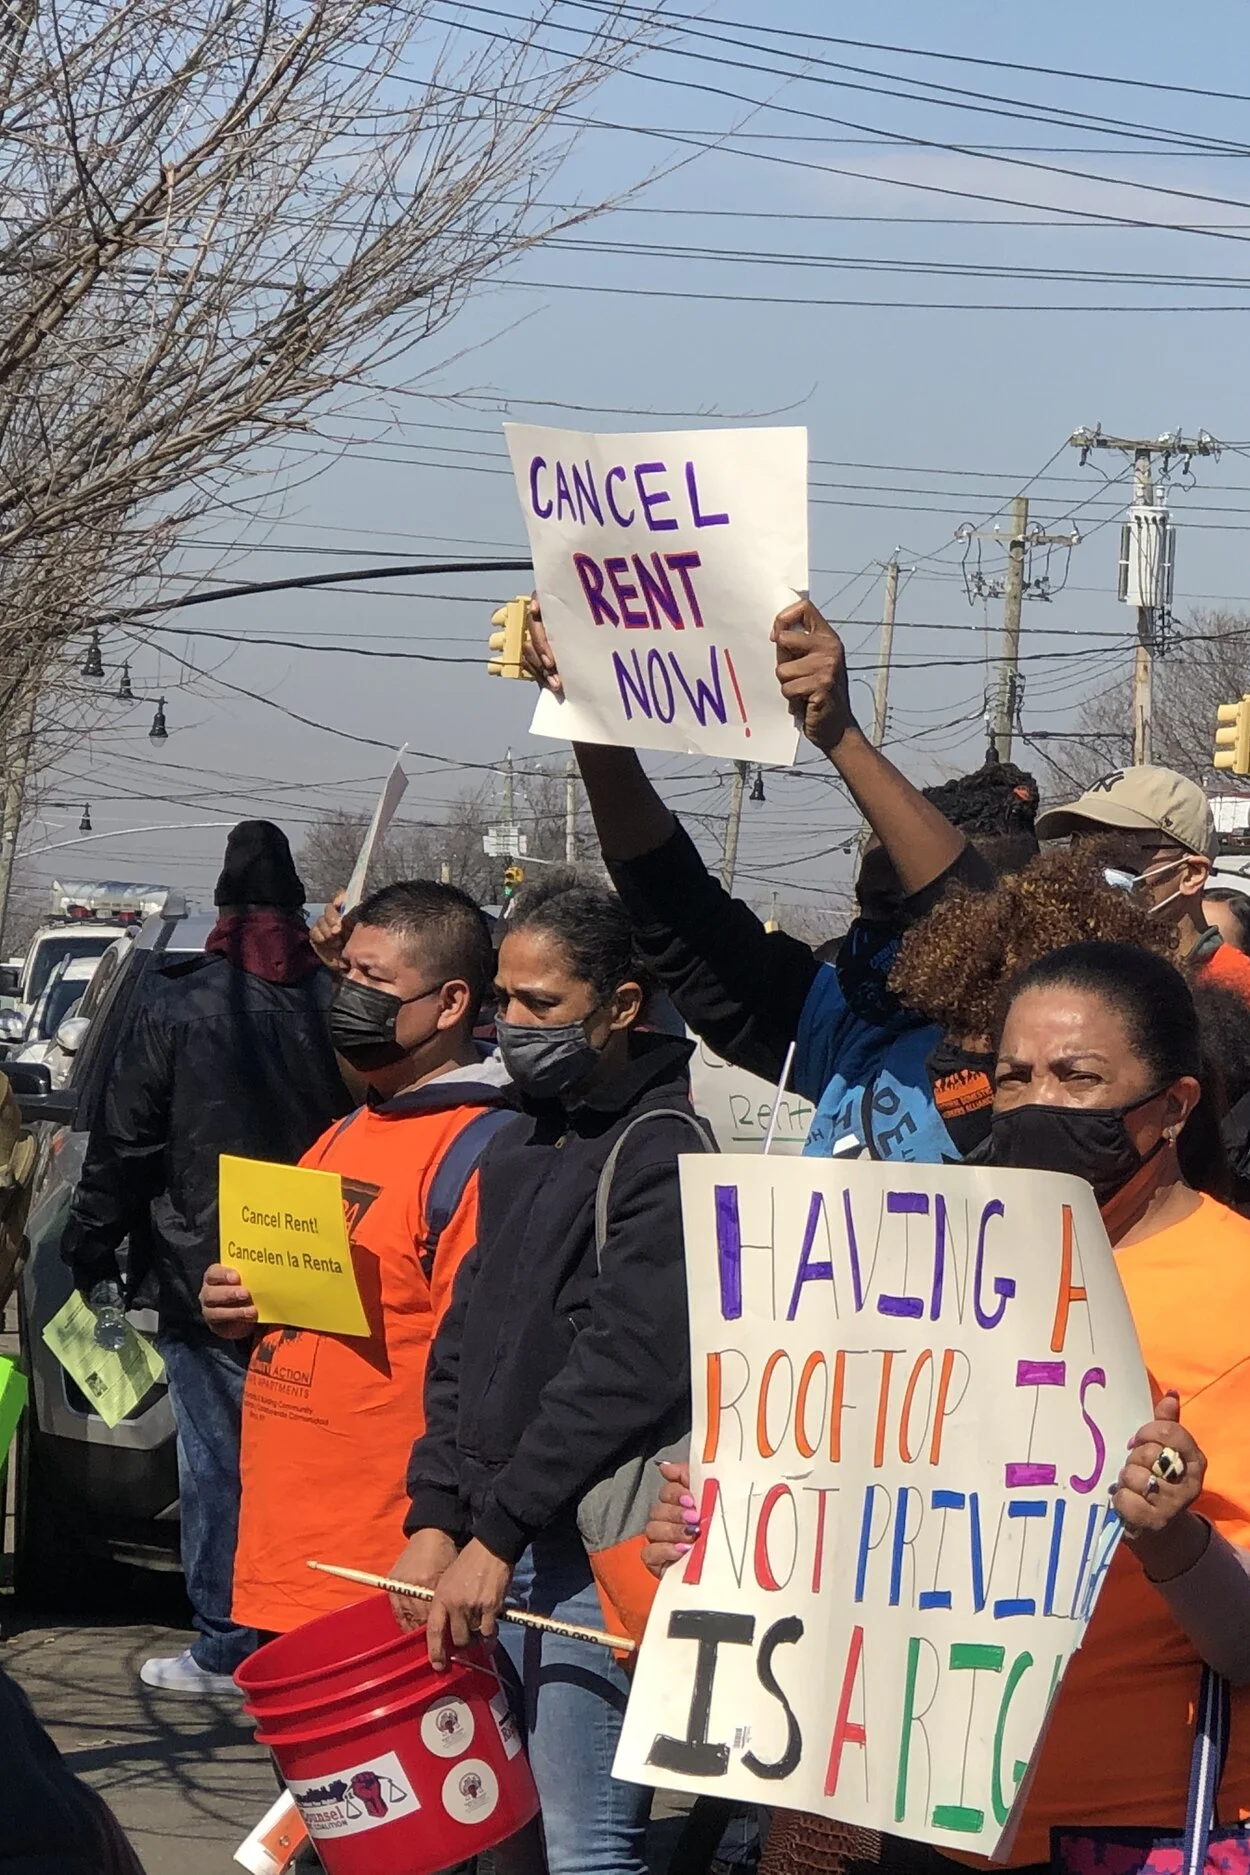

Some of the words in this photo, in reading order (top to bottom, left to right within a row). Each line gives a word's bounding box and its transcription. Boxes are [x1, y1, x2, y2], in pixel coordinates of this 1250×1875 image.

[529, 454, 730, 532] CANCEL
[572, 550, 705, 631] RENT
[612, 644, 753, 739] NOW!
[228, 1240, 284, 1266] Cancelen
[287, 1251, 300, 1268] la
[303, 1253, 343, 1274] Renta
[241, 1205, 281, 1229] Cancel
[284, 1212, 319, 1234] Rent!
[714, 1184, 1017, 1330] HAVING
[1050, 1203, 1095, 1355] A
[701, 1347, 971, 1468] ROOFTOP
[1005, 1359, 1107, 1494] IS
[682, 1477, 840, 1594] NOT
[644, 1609, 805, 1781] IS
[824, 1625, 869, 1804] A
